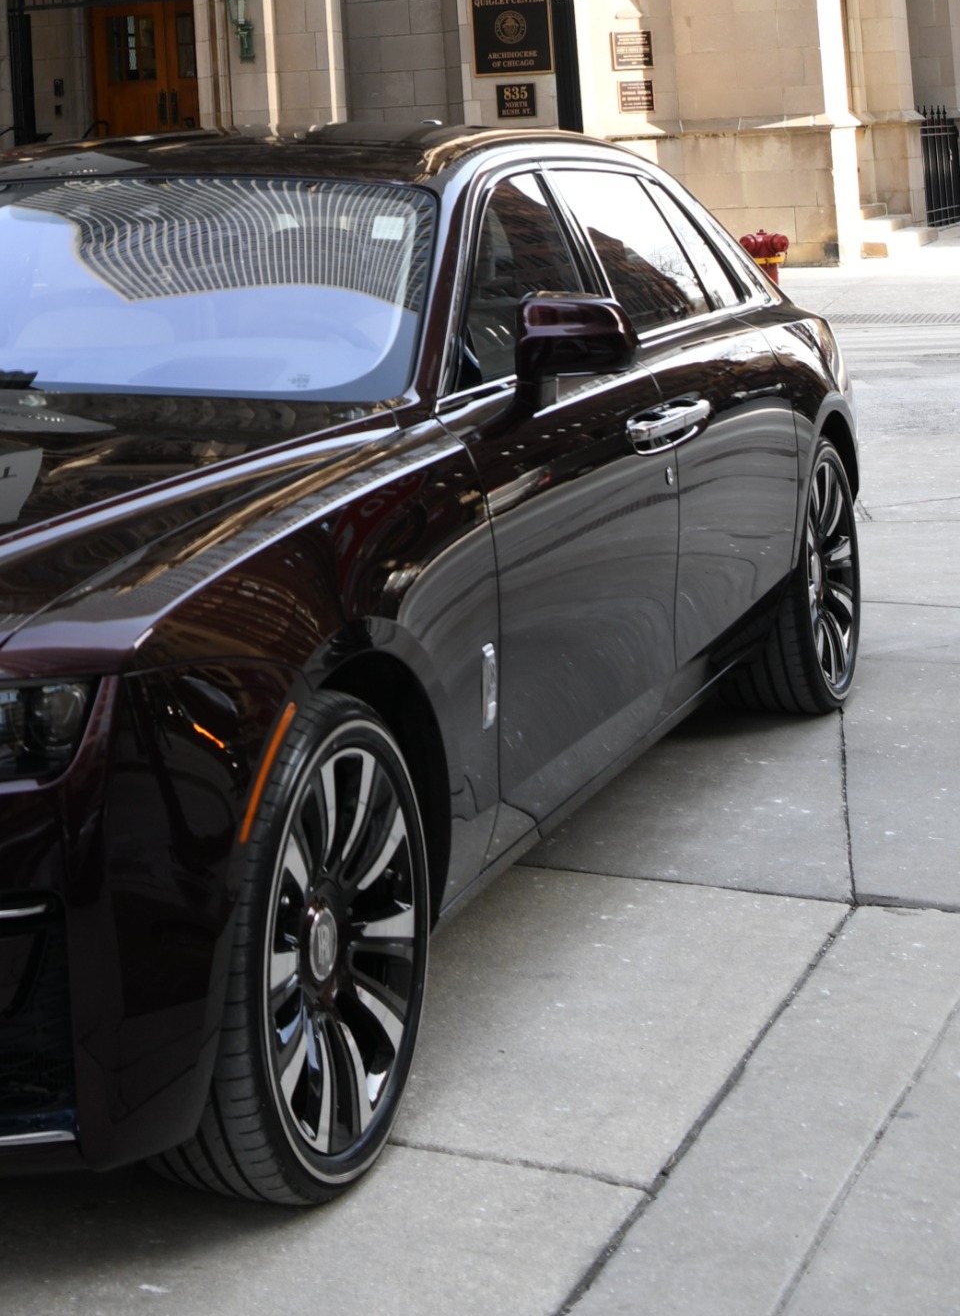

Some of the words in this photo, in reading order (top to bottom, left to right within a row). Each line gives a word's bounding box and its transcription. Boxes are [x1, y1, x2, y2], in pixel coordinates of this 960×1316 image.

[488, 50, 538, 60] ARCHDIOCESE
[502, 59, 535, 68] CHICAGO
[503, 86, 529, 101] 835
[505, 100, 528, 108] NORTH
